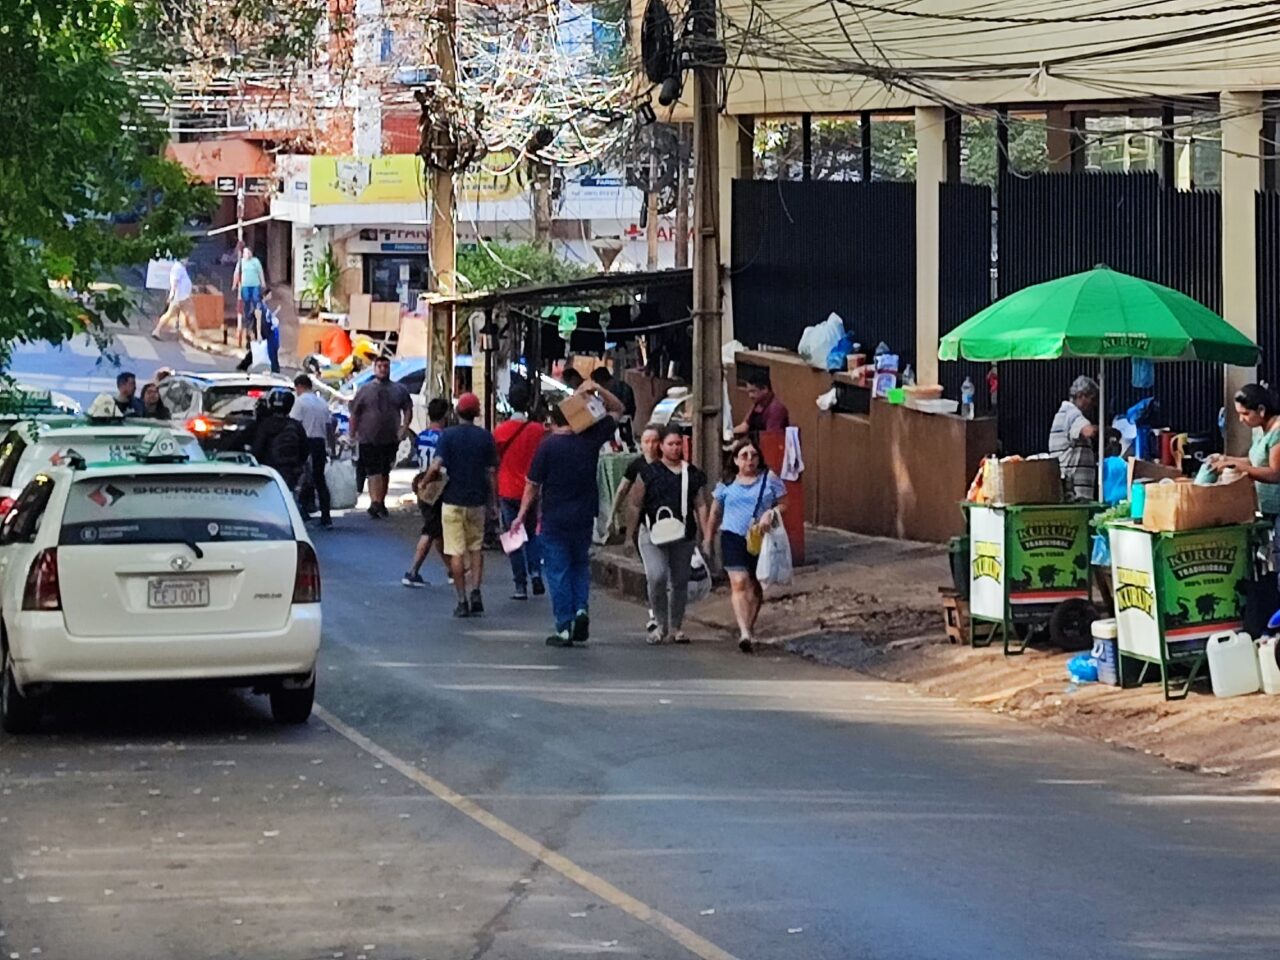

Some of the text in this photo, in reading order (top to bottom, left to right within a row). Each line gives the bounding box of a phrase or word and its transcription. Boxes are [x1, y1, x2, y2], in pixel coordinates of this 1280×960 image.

[160, 442, 174, 451] 01
[133, 486, 259, 498] SHOPPING CHINA
[180, 589, 203, 604] 001
